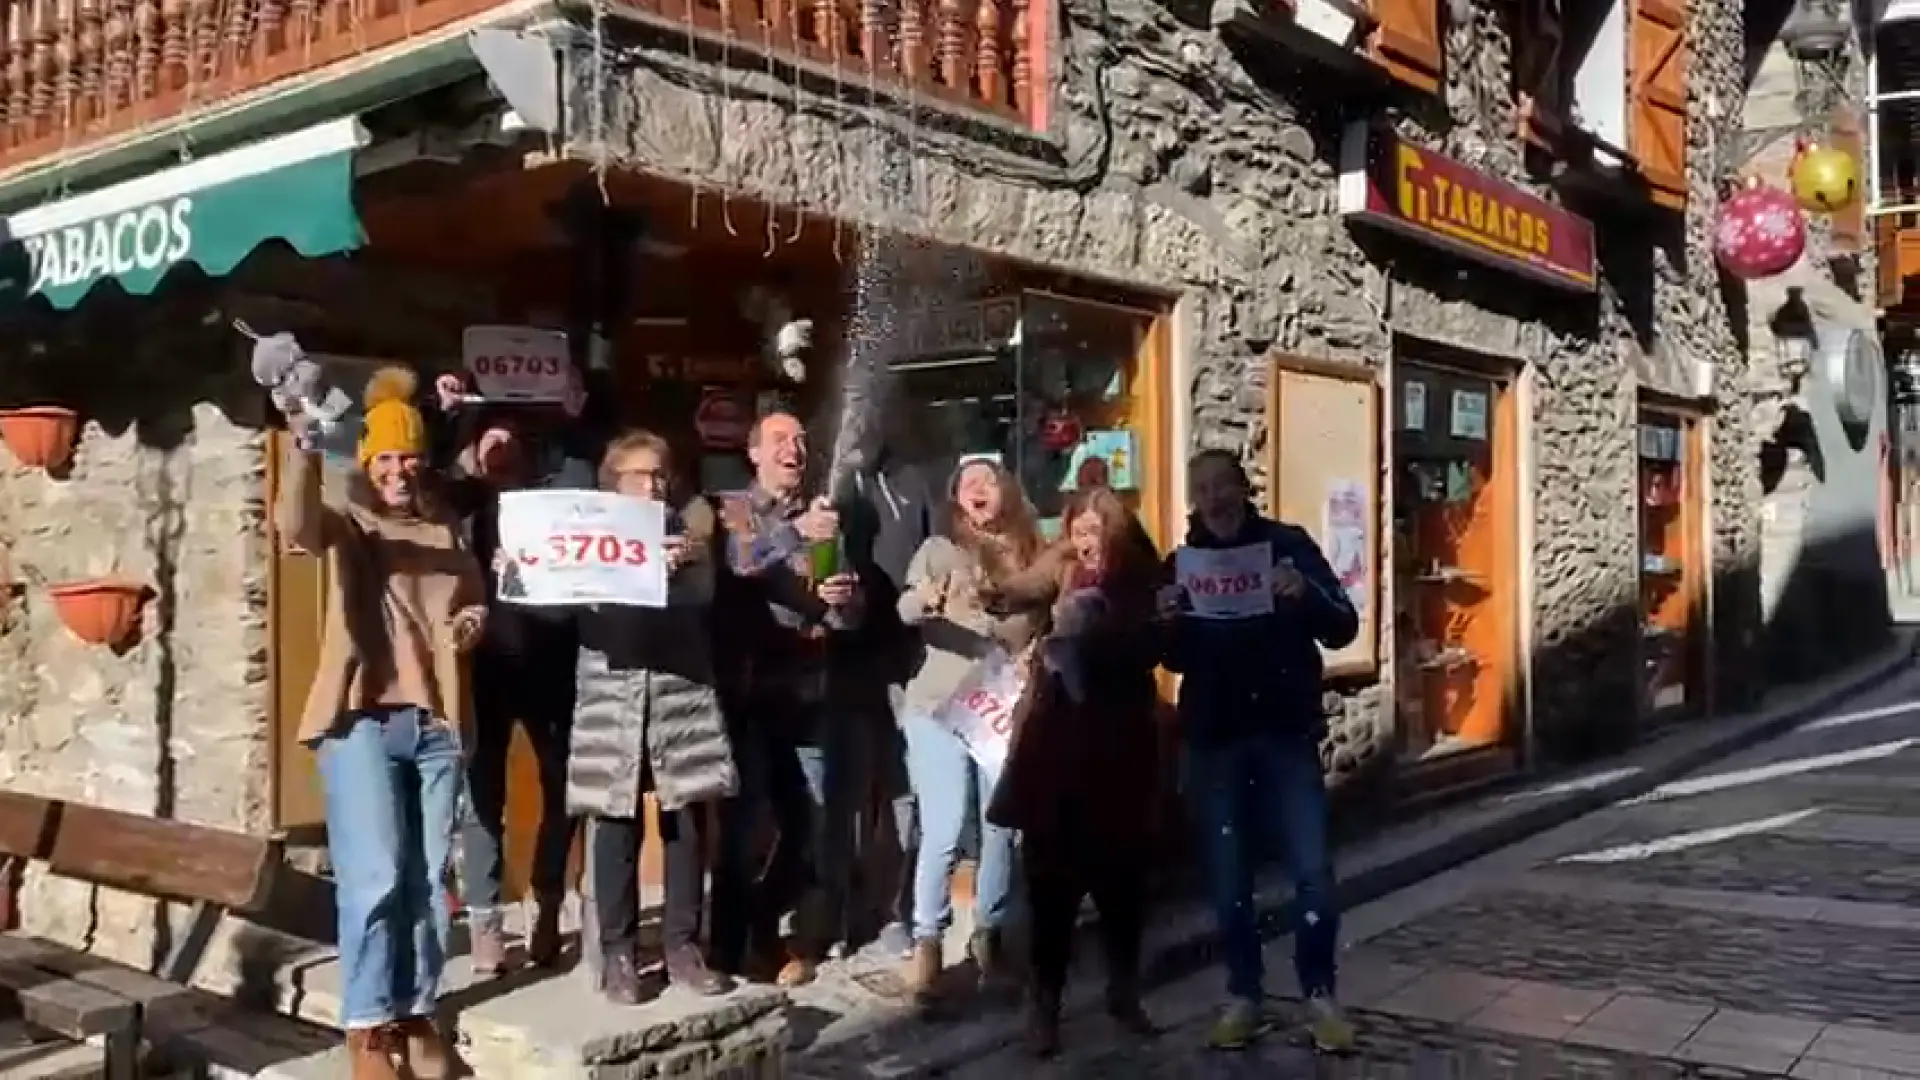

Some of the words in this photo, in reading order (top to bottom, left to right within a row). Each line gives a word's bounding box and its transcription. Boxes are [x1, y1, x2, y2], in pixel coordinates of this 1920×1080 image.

[24, 197, 192, 290] TABACOS
[1432, 174, 1549, 254] TABACOS
[475, 355, 560, 375] 06703
